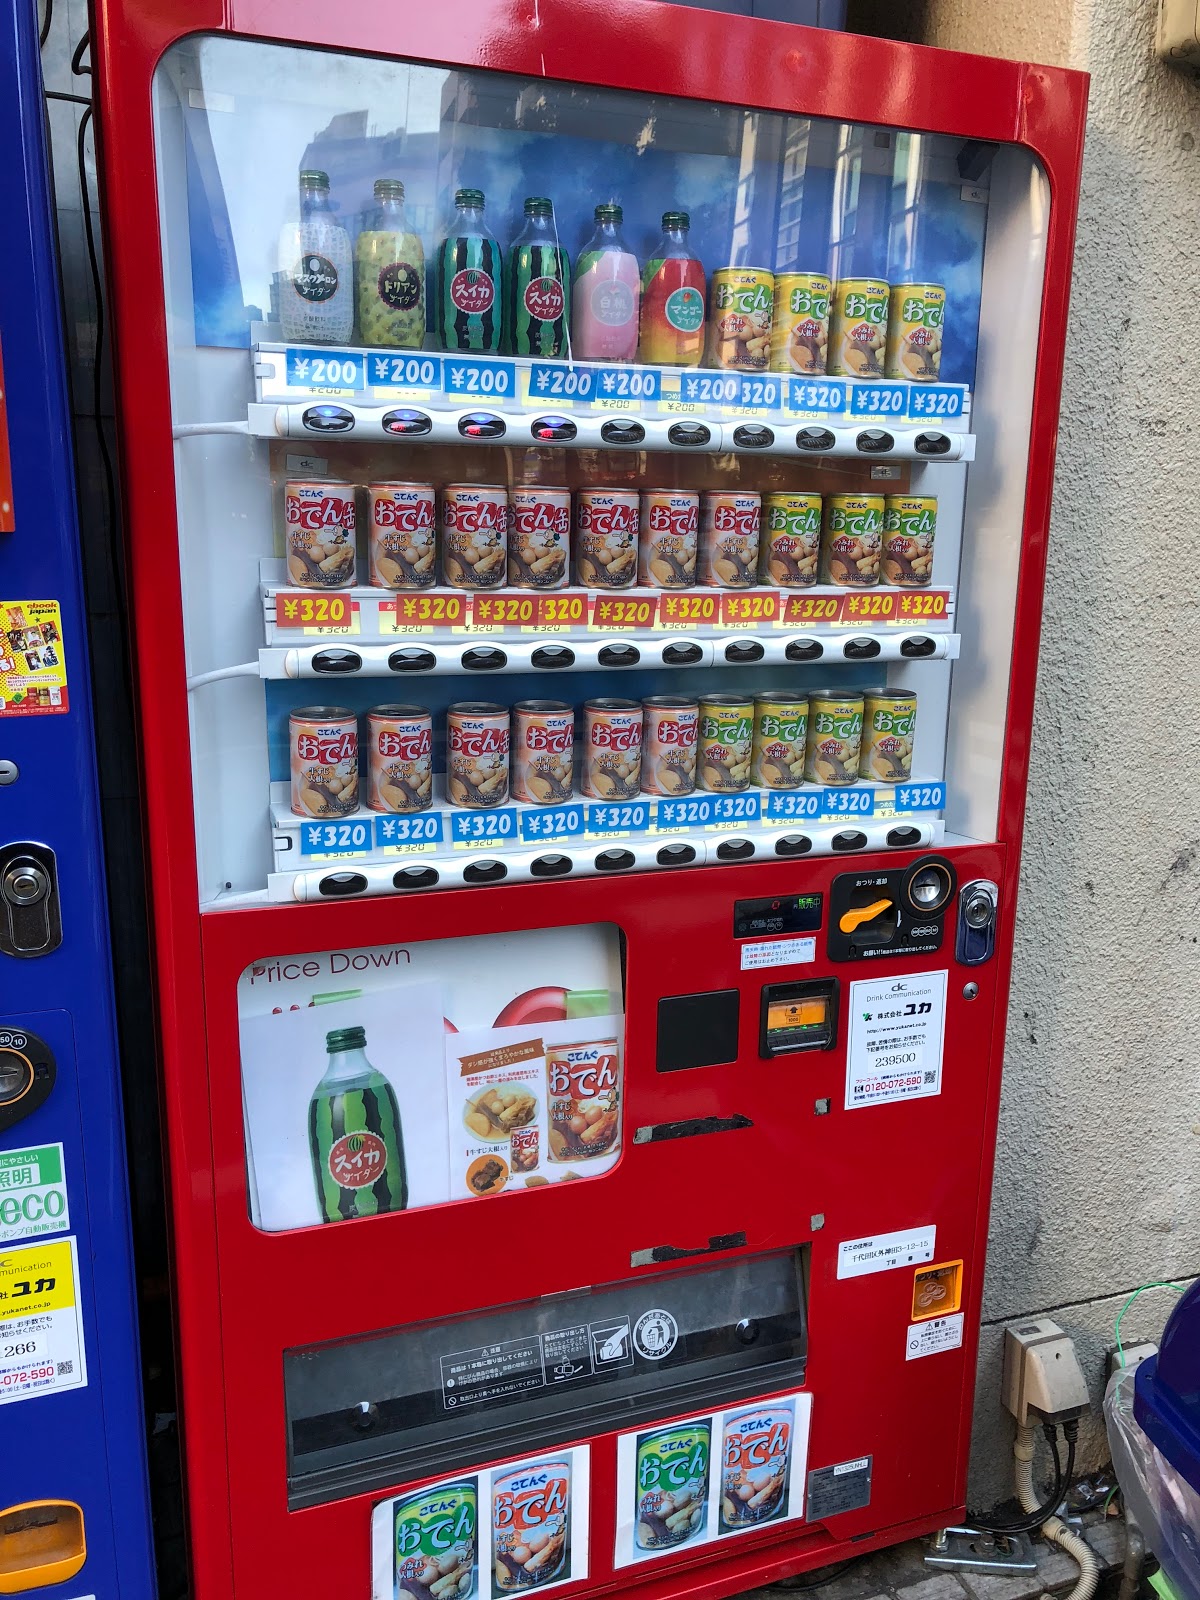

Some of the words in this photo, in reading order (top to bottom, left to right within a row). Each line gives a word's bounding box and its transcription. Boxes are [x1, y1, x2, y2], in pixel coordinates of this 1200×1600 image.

[385, 281, 417, 294] ドリアン
[456, 284, 490, 298] スイカ
[461, 298, 488, 308] サイダー
[529, 292, 561, 306] スイカ
[600, 296, 627, 309] 白桃
[718, 285, 773, 313] おでん
[534, 306, 559, 315] サイダー
[671, 306, 701, 314] マンゴー
[295, 358, 356, 383] ¥200
[375, 358, 434, 383] ¥200
[451, 367, 508, 393] ¥200
[537, 368, 591, 395] ¥200
[603, 373, 655, 395] ¥200
[687, 378, 736, 400] ¥200
[742, 383, 776, 404] 320
[794, 385, 841, 408] ¥320
[857, 390, 902, 412] ¥320
[668, 403, 694, 412] ¥200
[914, 393, 959, 414] ¥320
[299, 490, 323, 498] こてんぐ
[376, 501, 436, 531] おでん
[770, 509, 822, 534] おでん
[830, 510, 884, 535] おでん
[885, 511, 937, 536] おでん
[284, 599, 344, 621] ¥320
[404, 598, 460, 620] ¥320
[479, 600, 533, 620] ¥320
[539, 599, 583, 620] 320
[600, 602, 649, 622] ¥320
[666, 598, 714, 617] ¥320
[728, 597, 774, 617] ¥320
[791, 600, 837, 617] ¥320
[849, 596, 892, 615] ¥320
[902, 596, 944, 614] ¥320
[461, 722, 484, 730] こてんぐ
[546, 719, 566, 727] こてんぐ
[678, 714, 695, 722] こてんぐ
[318, 728, 341, 736] こてんぐ
[400, 725, 421, 733] こてんぐ
[299, 734, 358, 764] おでん
[773, 796, 817, 815] ¥320
[827, 793, 870, 810] ¥320
[900, 787, 941, 806] ¥320
[594, 806, 644, 827] ¥320
[664, 802, 709, 822] ¥320
[383, 818, 438, 839] ¥320
[458, 814, 511, 836] ¥320
[529, 812, 578, 834] ¥320
[308, 825, 365, 847] ¥320
[855, 878, 887, 887] おつり・返却
[799, 897, 820, 909] 販売中
[250, 958, 320, 985] Price
[330, 948, 411, 975] Down
[885, 989, 931, 999] Communication
[891, 983, 908, 991] dc
[878, 1011, 902, 1019] 株式会社
[904, 1002, 932, 1016] ユカ
[1, 1036, 9, 1044] 50
[14, 1038, 22, 1046] 10
[568, 1050, 598, 1061] こてんぐ
[875, 1053, 916, 1067] 239500
[550, 1057, 616, 1096] おでん
[865, 1076, 921, 1092] 0120-072-590
[511, 1134, 538, 1147] おでん
[334, 1149, 380, 1173] スイカ
[343, 1166, 379, 1182] サイダー
[0, 1221, 67, 1237] ポンプ自動販売機
[843, 1242, 873, 1252] ここの住所は
[852, 1241, 928, 1262] 千代田区外神田3-12-15
[12, 1278, 56, 1298] ユカ
[0, 1341, 36, 1358] 266
[643, 1342, 672, 1355] リサイクル
[740, 1417, 773, 1433] こてんぐ
[660, 1438, 692, 1453] こてんぐ
[724, 1425, 788, 1466] おでん
[640, 1445, 706, 1486] おでん
[510, 1474, 548, 1491] こてんぐ
[419, 1500, 457, 1516] こてんぐ
[494, 1481, 566, 1525] おでん
[399, 1505, 474, 1552] おでん
